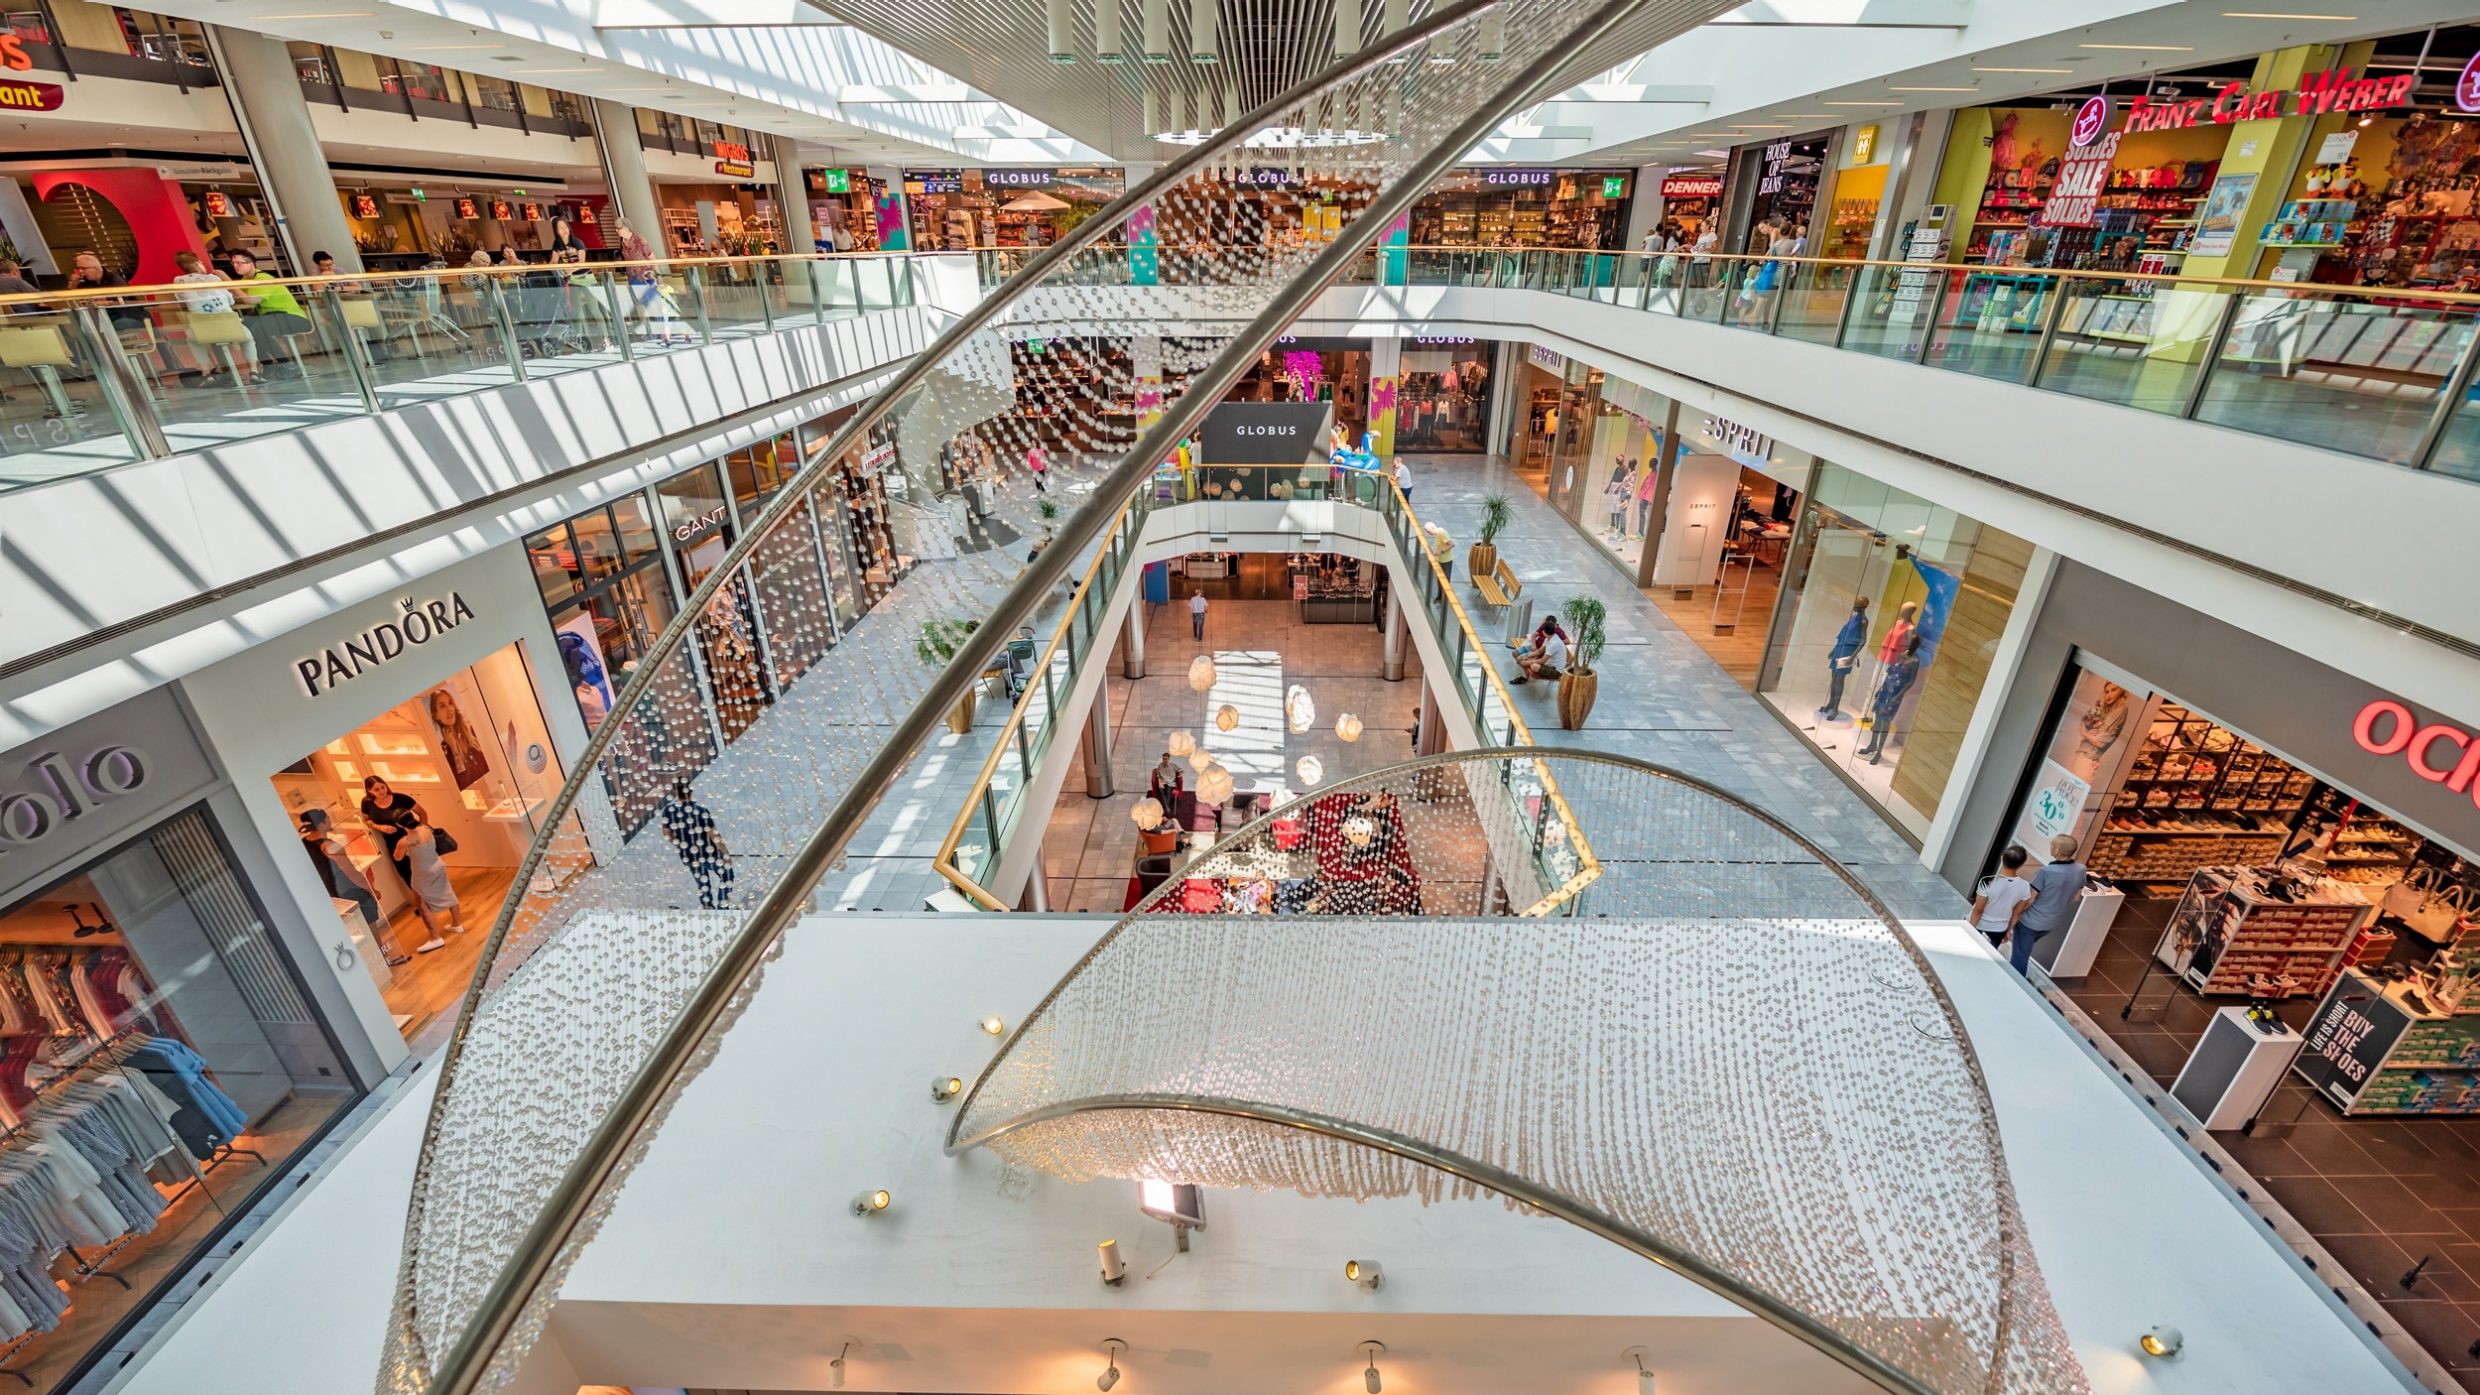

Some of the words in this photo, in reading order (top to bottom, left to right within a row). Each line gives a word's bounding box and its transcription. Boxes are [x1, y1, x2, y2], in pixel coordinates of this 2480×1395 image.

[0, 34, 33, 71] S
[713, 139, 749, 161] MIGROS
[1765, 142, 1792, 161] HOUSE
[989, 173, 1050, 184] GLOBUS
[1488, 173, 1550, 184] GLOBUS
[1769, 160, 1781, 177] OF
[2055, 161, 2108, 197] SALE
[1663, 181, 1720, 194] DENNER
[1759, 176, 1783, 196] JEANS
[2041, 198, 2097, 224] SOLDES
[1417, 335, 1475, 344] GLOBUS
[1236, 425, 1297, 436] GLOBUS
[675, 505, 726, 541] GANT
[297, 591, 476, 698] PANDORA
[0, 745, 155, 846] olo
[2039, 790, 2065, 820] 30%
[2326, 1000, 2349, 1028] SHORT
[2343, 1009, 2375, 1039] BUY
[2310, 1031, 2328, 1051] LIFE
[2320, 1023, 2333, 1037] IS
[2333, 1024, 2360, 1053] THE
[2322, 1041, 2367, 1082] SHOES
